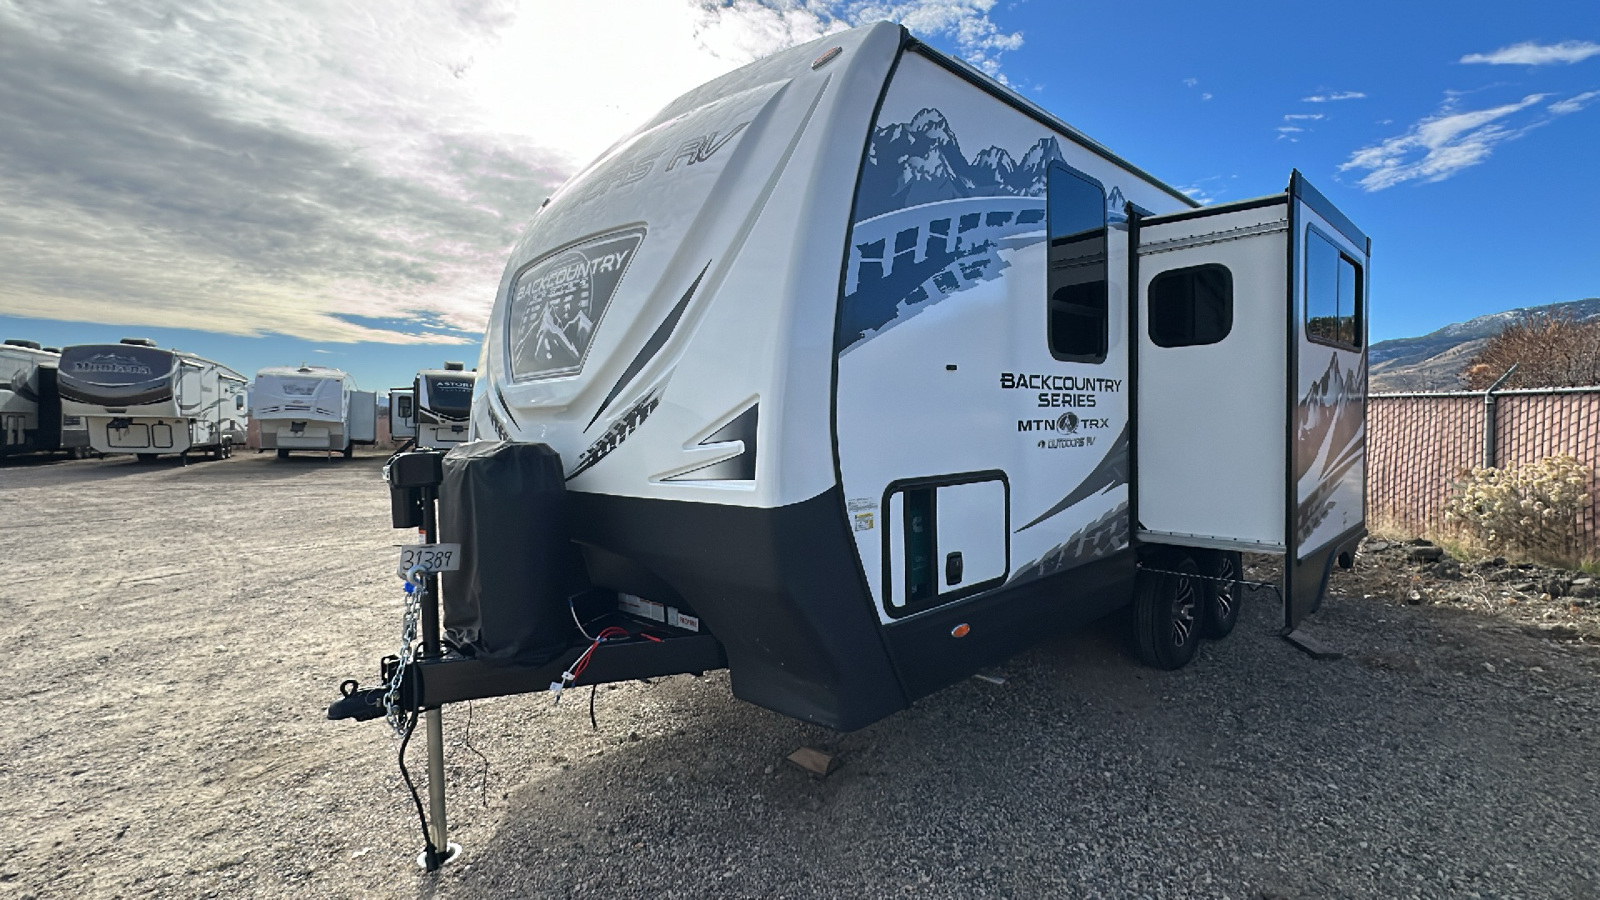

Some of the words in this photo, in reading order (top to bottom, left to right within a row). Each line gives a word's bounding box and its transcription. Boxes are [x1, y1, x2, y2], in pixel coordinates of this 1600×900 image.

[517, 249, 630, 301] BACKCOUNTRY
[1000, 372, 1122, 392] BACKCOUNTRY
[1038, 393, 1096, 407] SERIES
[1018, 420, 1055, 431] MTN
[1081, 418, 1109, 429] TRX
[1047, 438, 1084, 449] OUTDOORS
[403, 550, 452, 570] 31389
